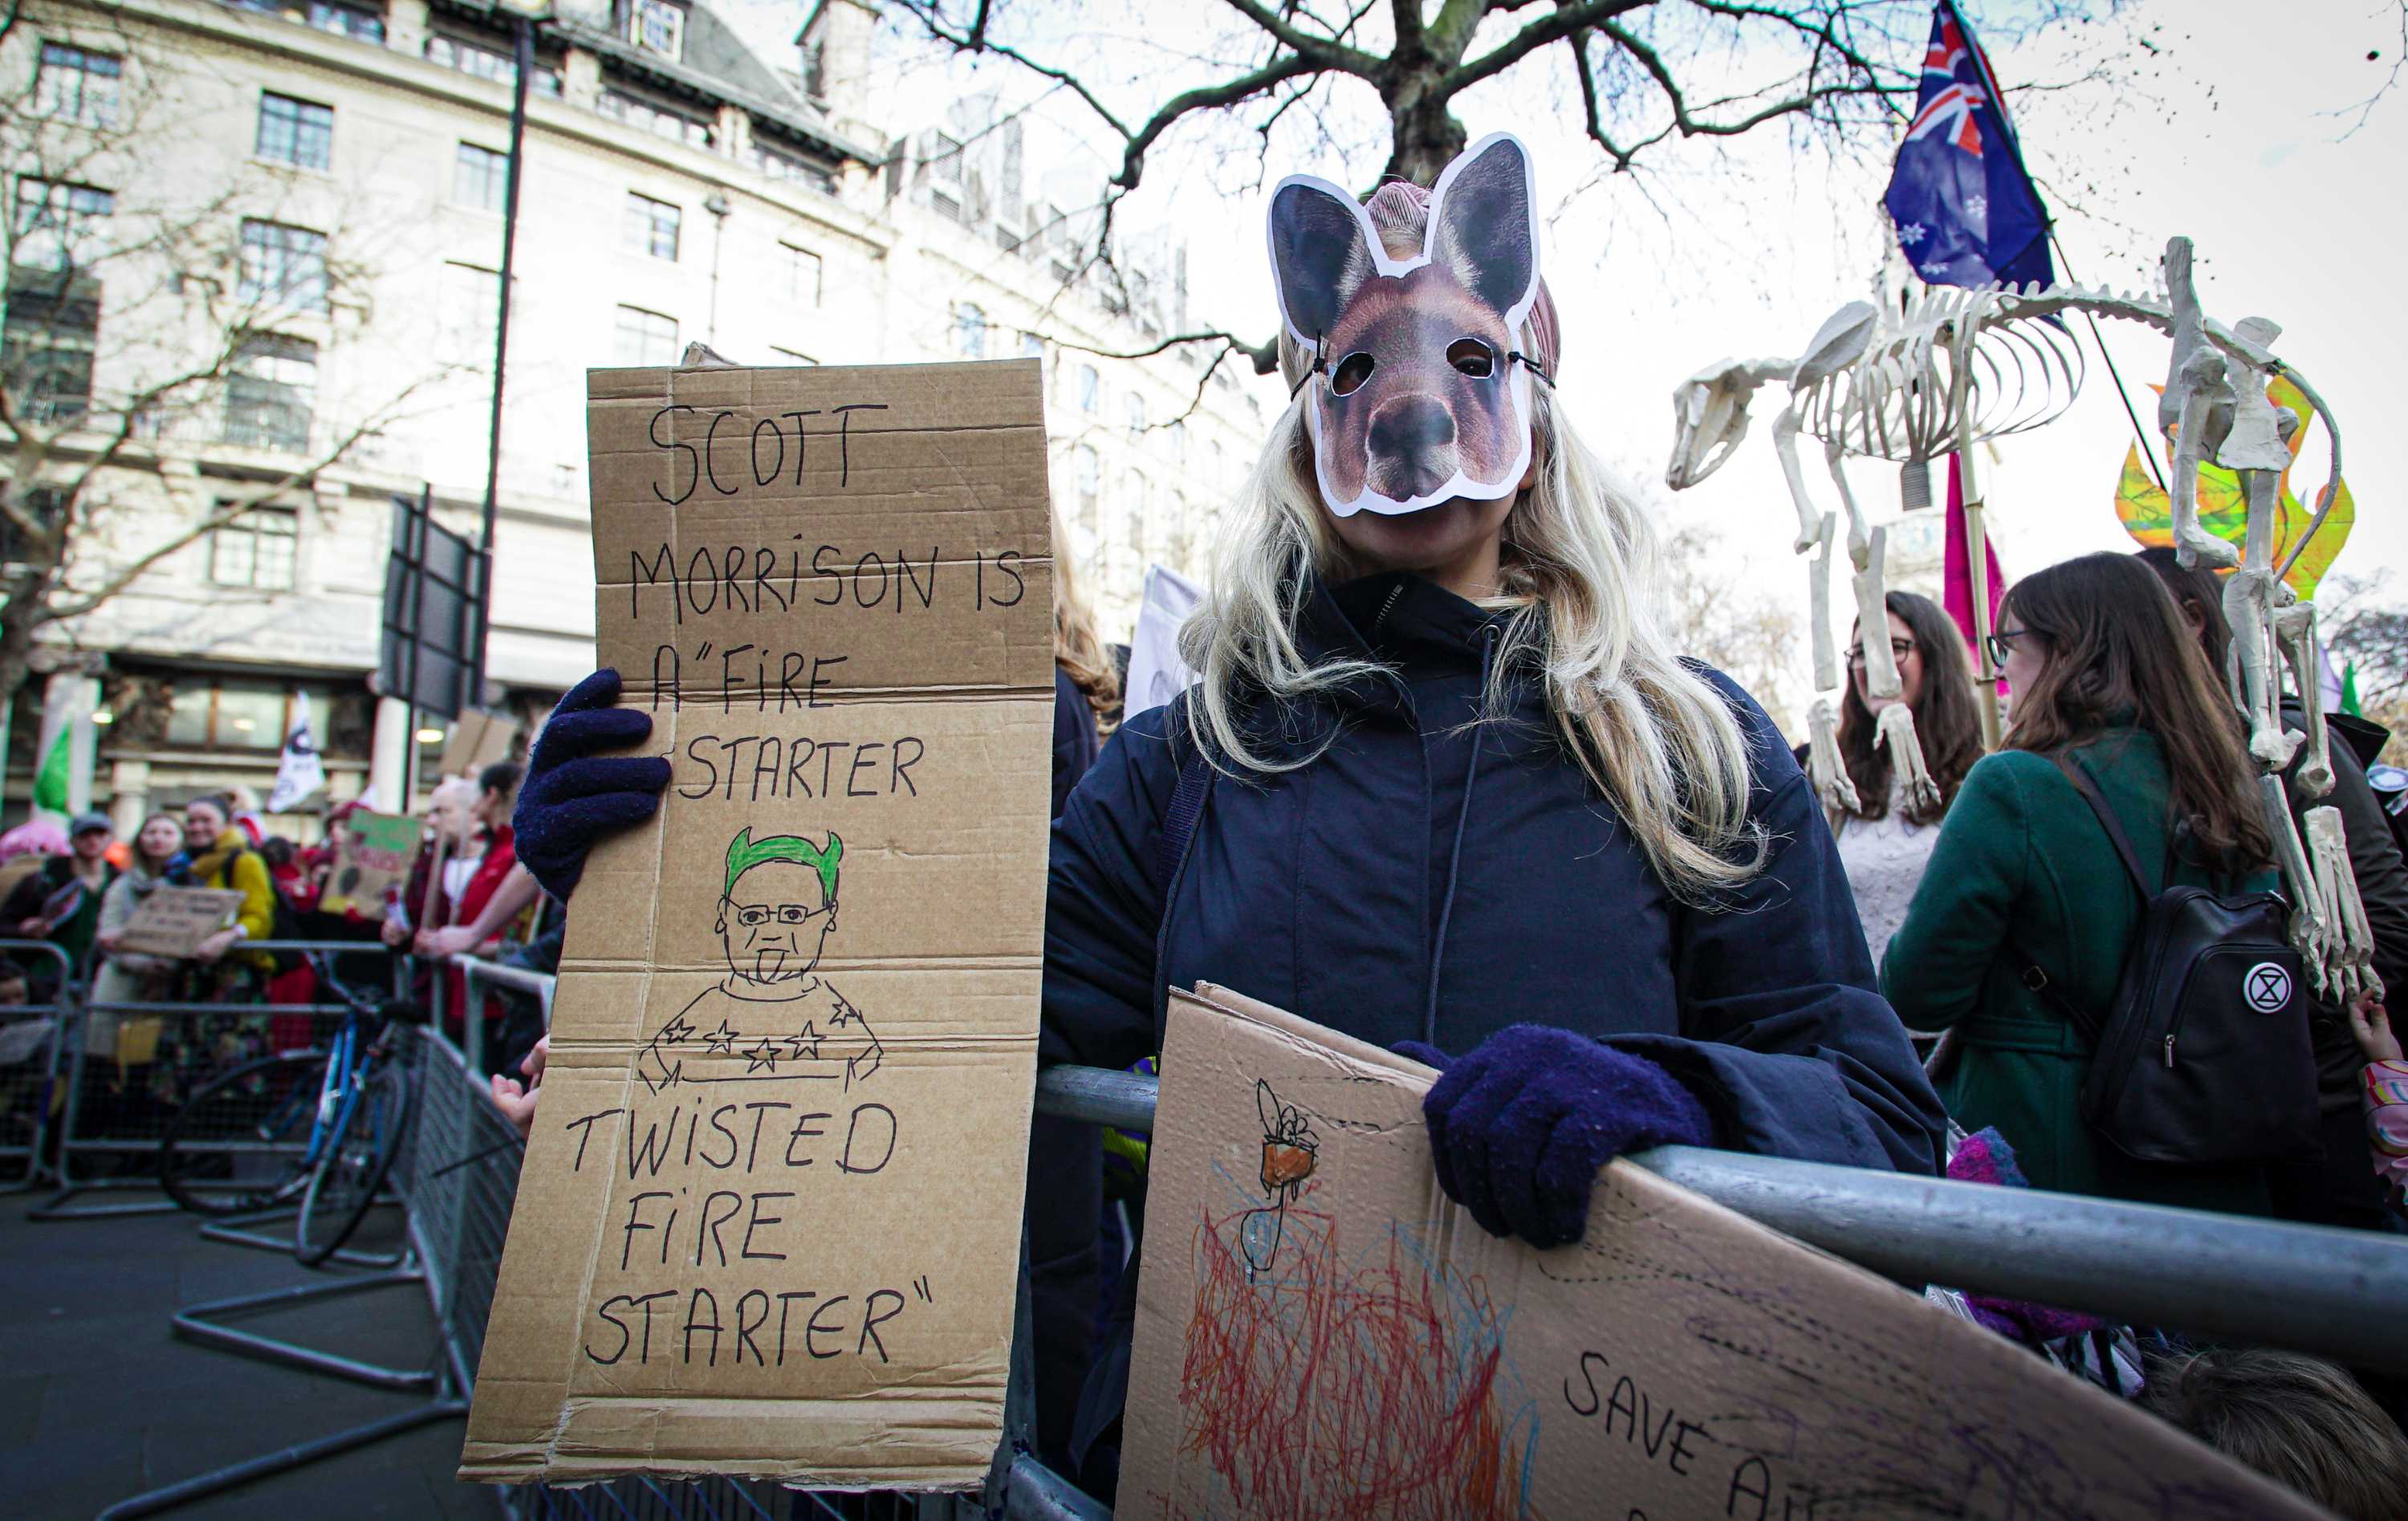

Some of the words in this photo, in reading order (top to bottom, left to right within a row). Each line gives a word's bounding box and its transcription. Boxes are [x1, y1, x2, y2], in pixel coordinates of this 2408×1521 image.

[649, 404, 889, 506] SCOTT
[975, 550, 1025, 612] IS
[652, 645, 681, 712] A
[677, 735, 925, 801] STARTER
[585, 1276, 933, 1366] STARTER"
[1564, 1351, 1711, 1476] SAVE
